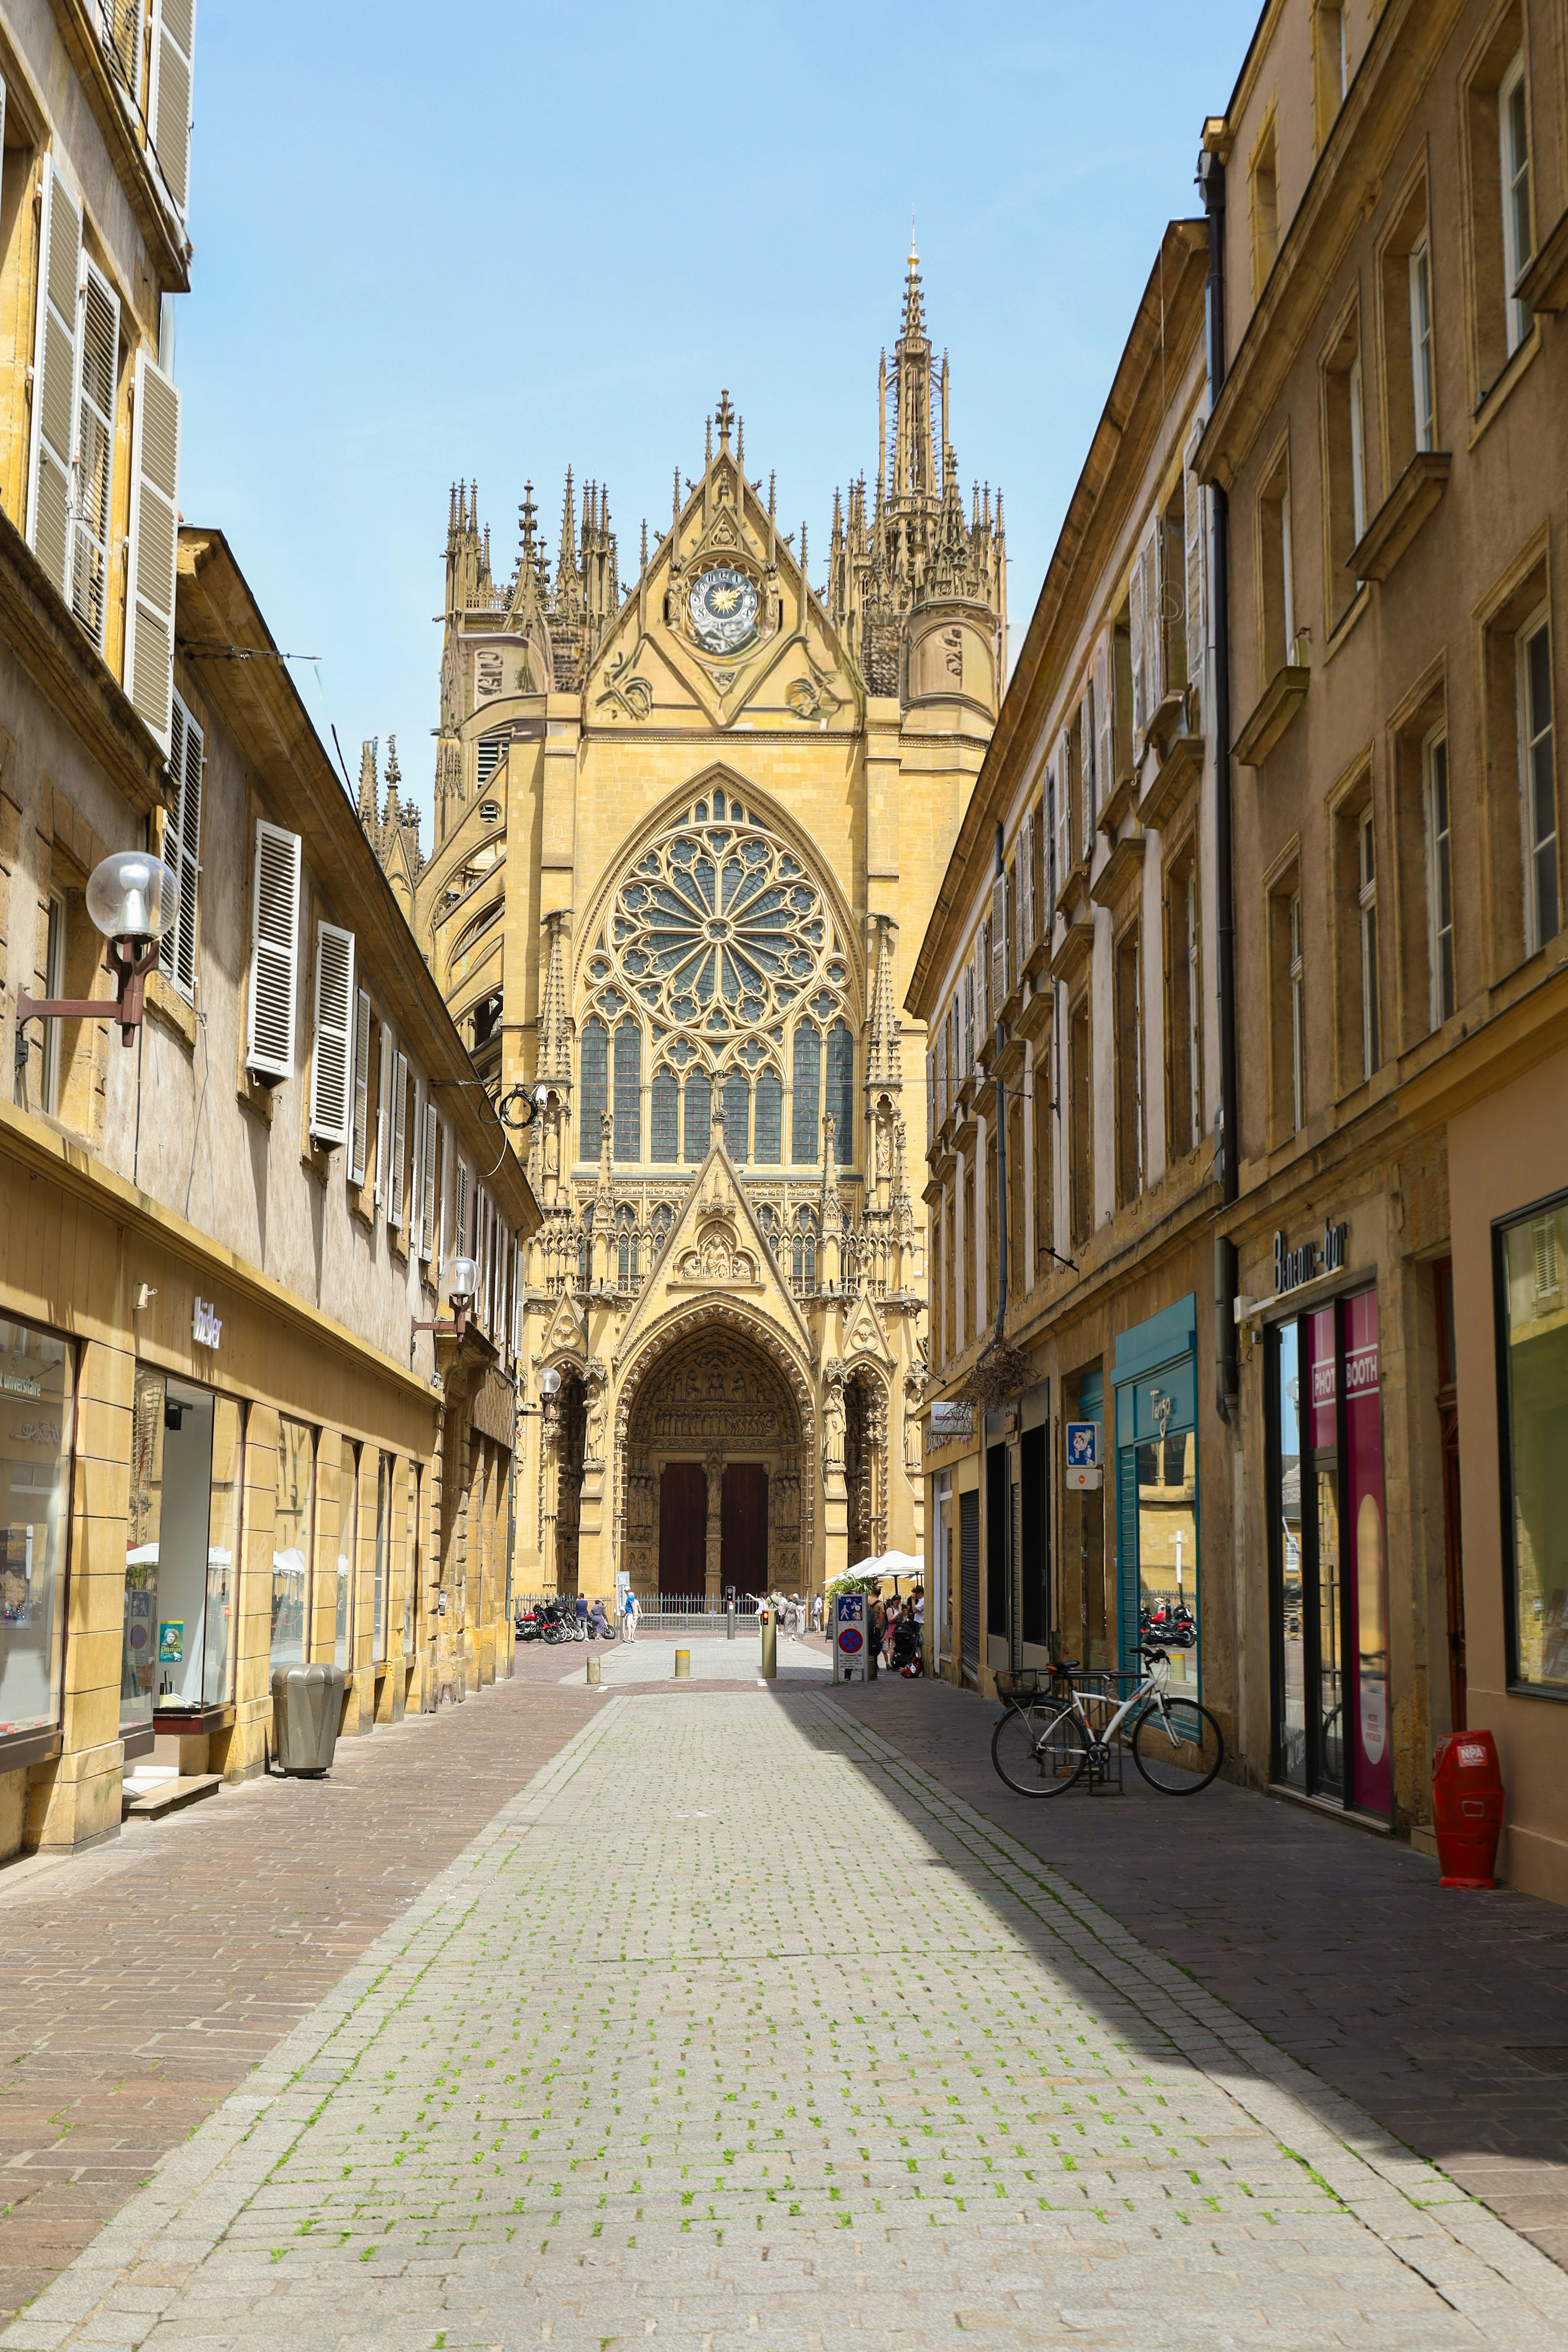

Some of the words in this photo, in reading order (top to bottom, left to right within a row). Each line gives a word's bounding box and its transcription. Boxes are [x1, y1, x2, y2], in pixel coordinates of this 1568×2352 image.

[193, 1297, 223, 1349] hisler
[4, 1371, 41, 1397] universitaire
[1315, 1368, 1335, 1396] PHOT
[1347, 1355, 1377, 1387] BOOTH
[1150, 1390, 1170, 1438] Tango
[1461, 1748, 1484, 1759] NPA
